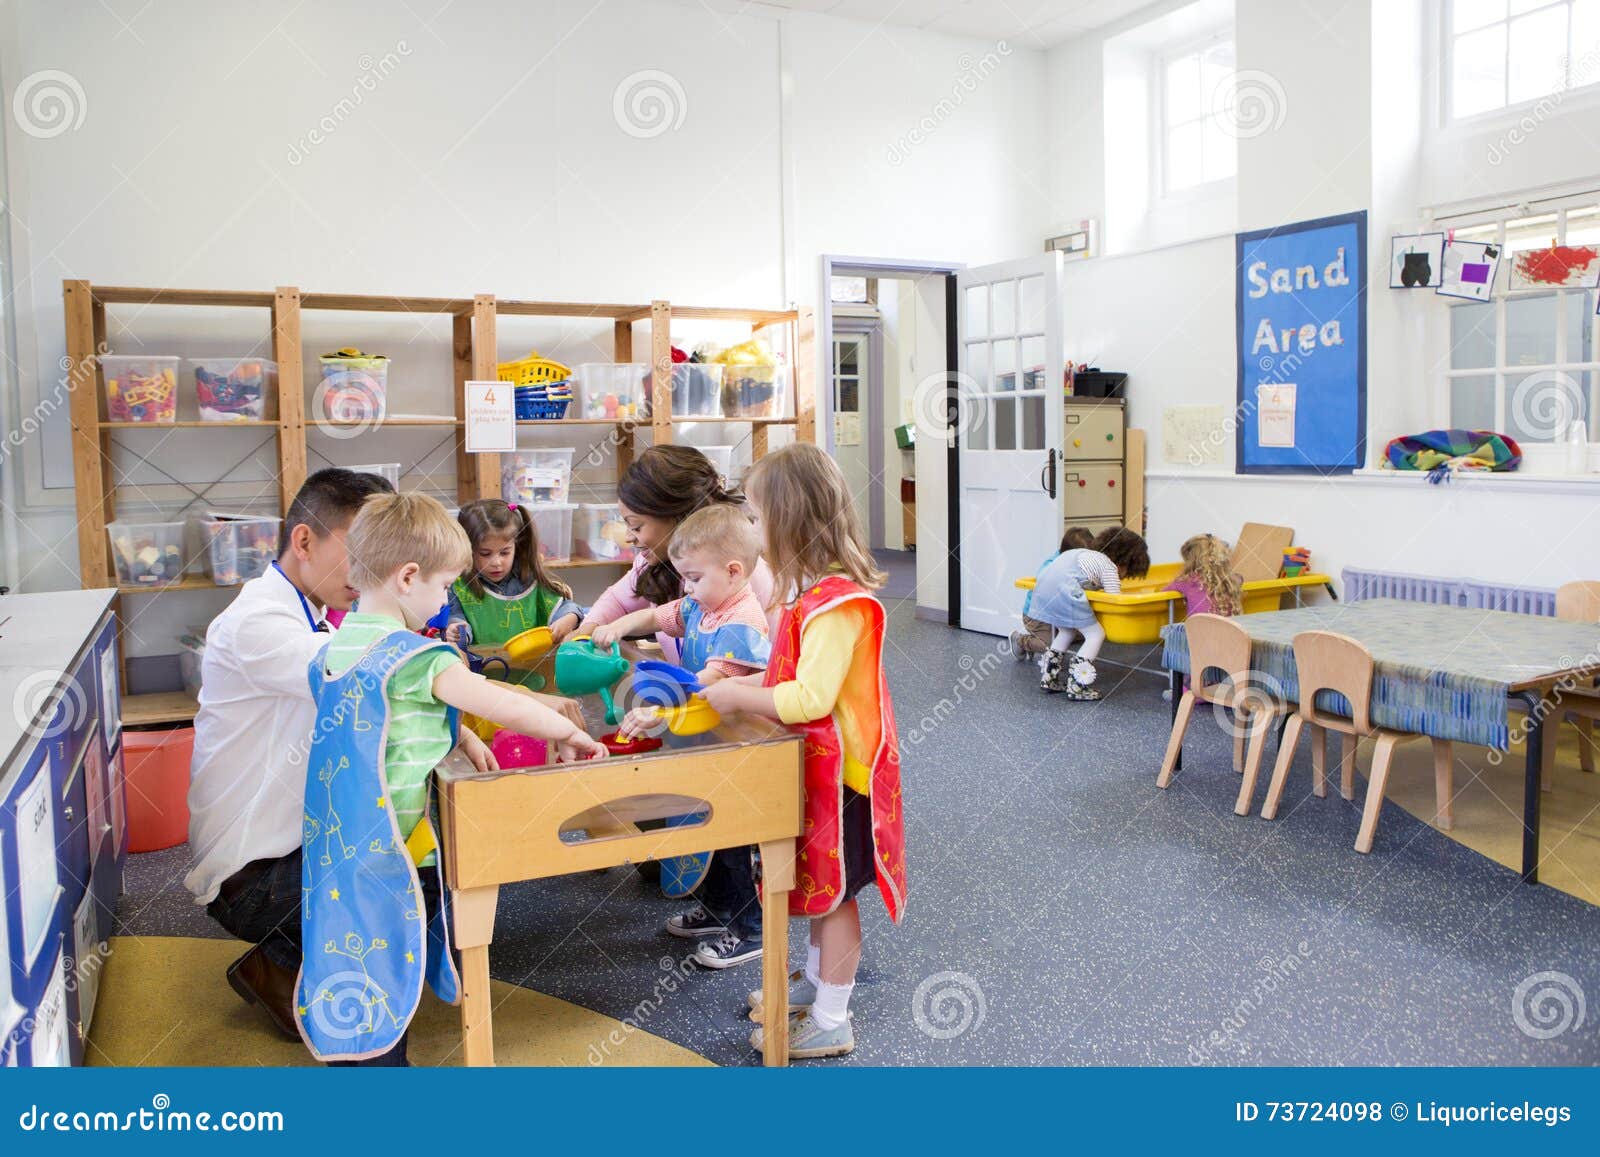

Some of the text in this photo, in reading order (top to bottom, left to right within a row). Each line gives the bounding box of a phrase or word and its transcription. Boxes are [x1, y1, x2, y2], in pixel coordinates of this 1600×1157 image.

[1248, 247, 1349, 299] Sand
[1252, 319, 1345, 355] Area
[484, 387, 497, 405] 4
